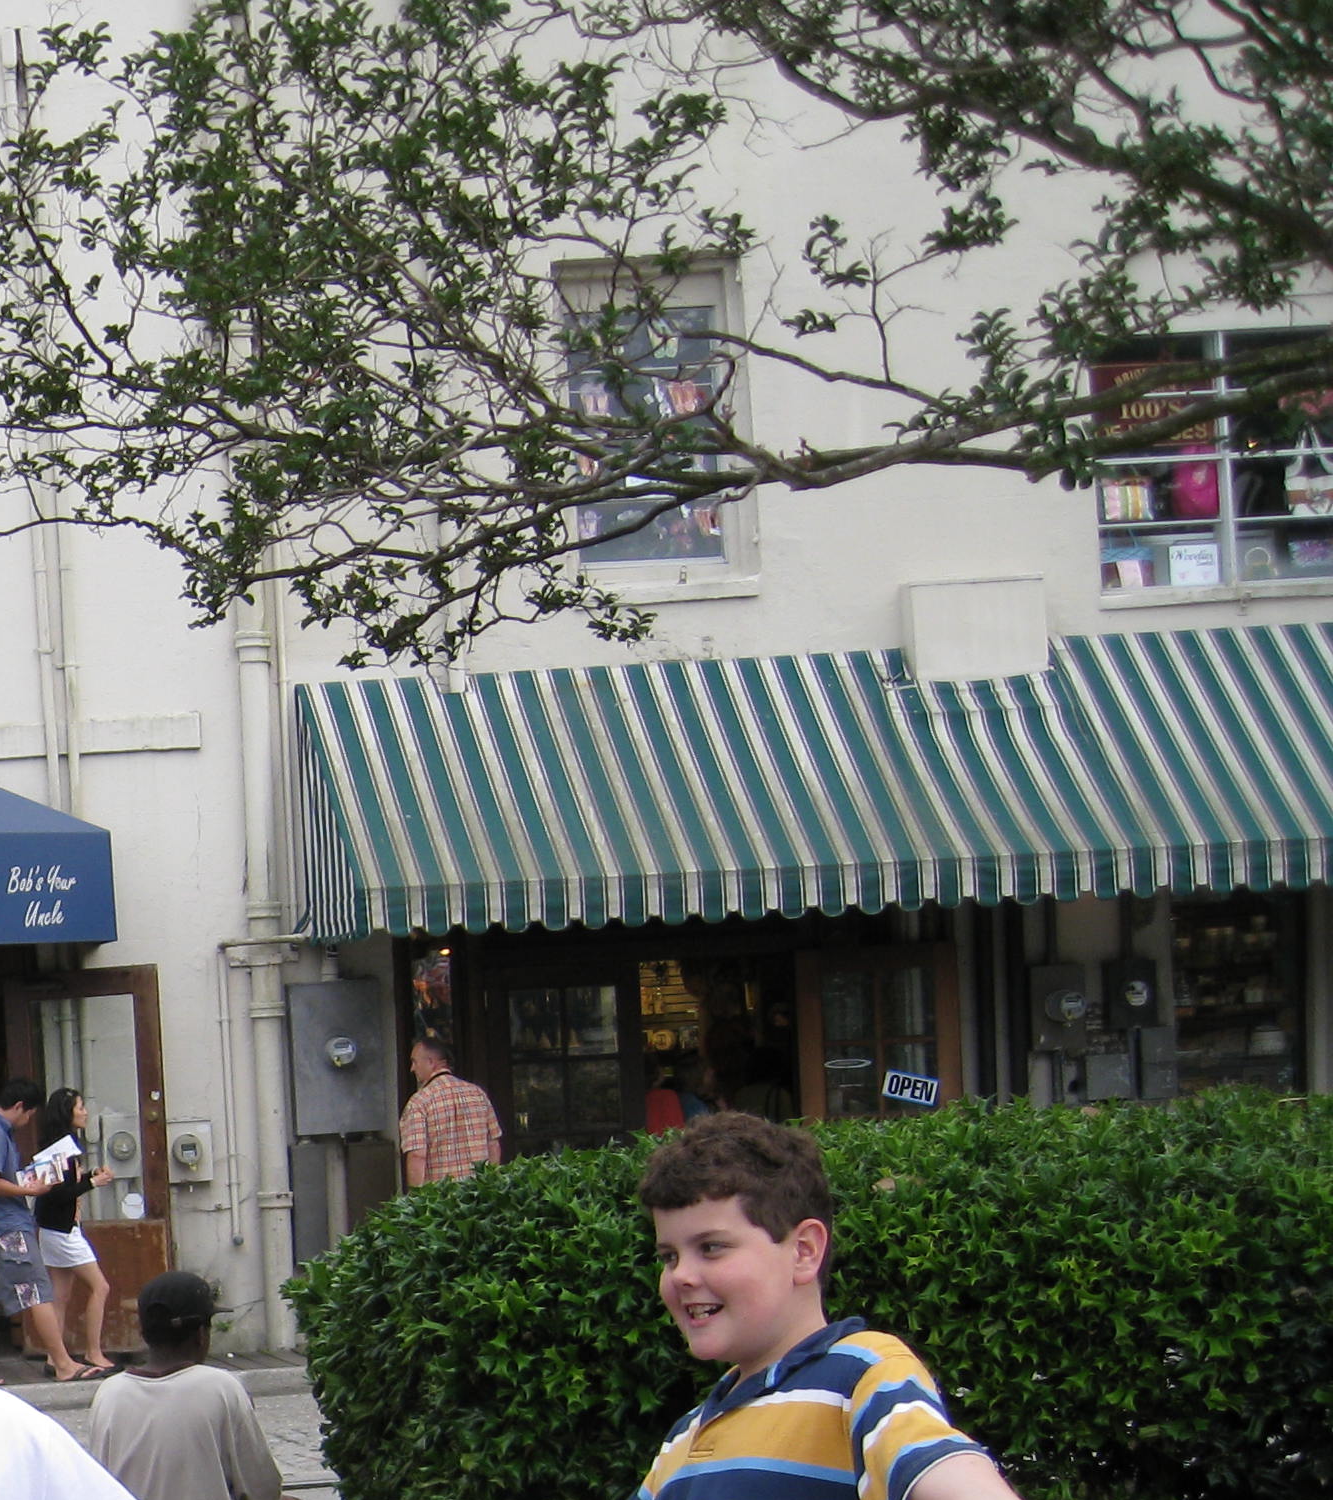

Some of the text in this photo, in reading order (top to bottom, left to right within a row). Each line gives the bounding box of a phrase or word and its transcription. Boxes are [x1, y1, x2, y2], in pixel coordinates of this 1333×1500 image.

[7, 864, 77, 894] Bob's Your
[25, 900, 65, 928] Uncle
[888, 1075, 935, 1102] OPEN
